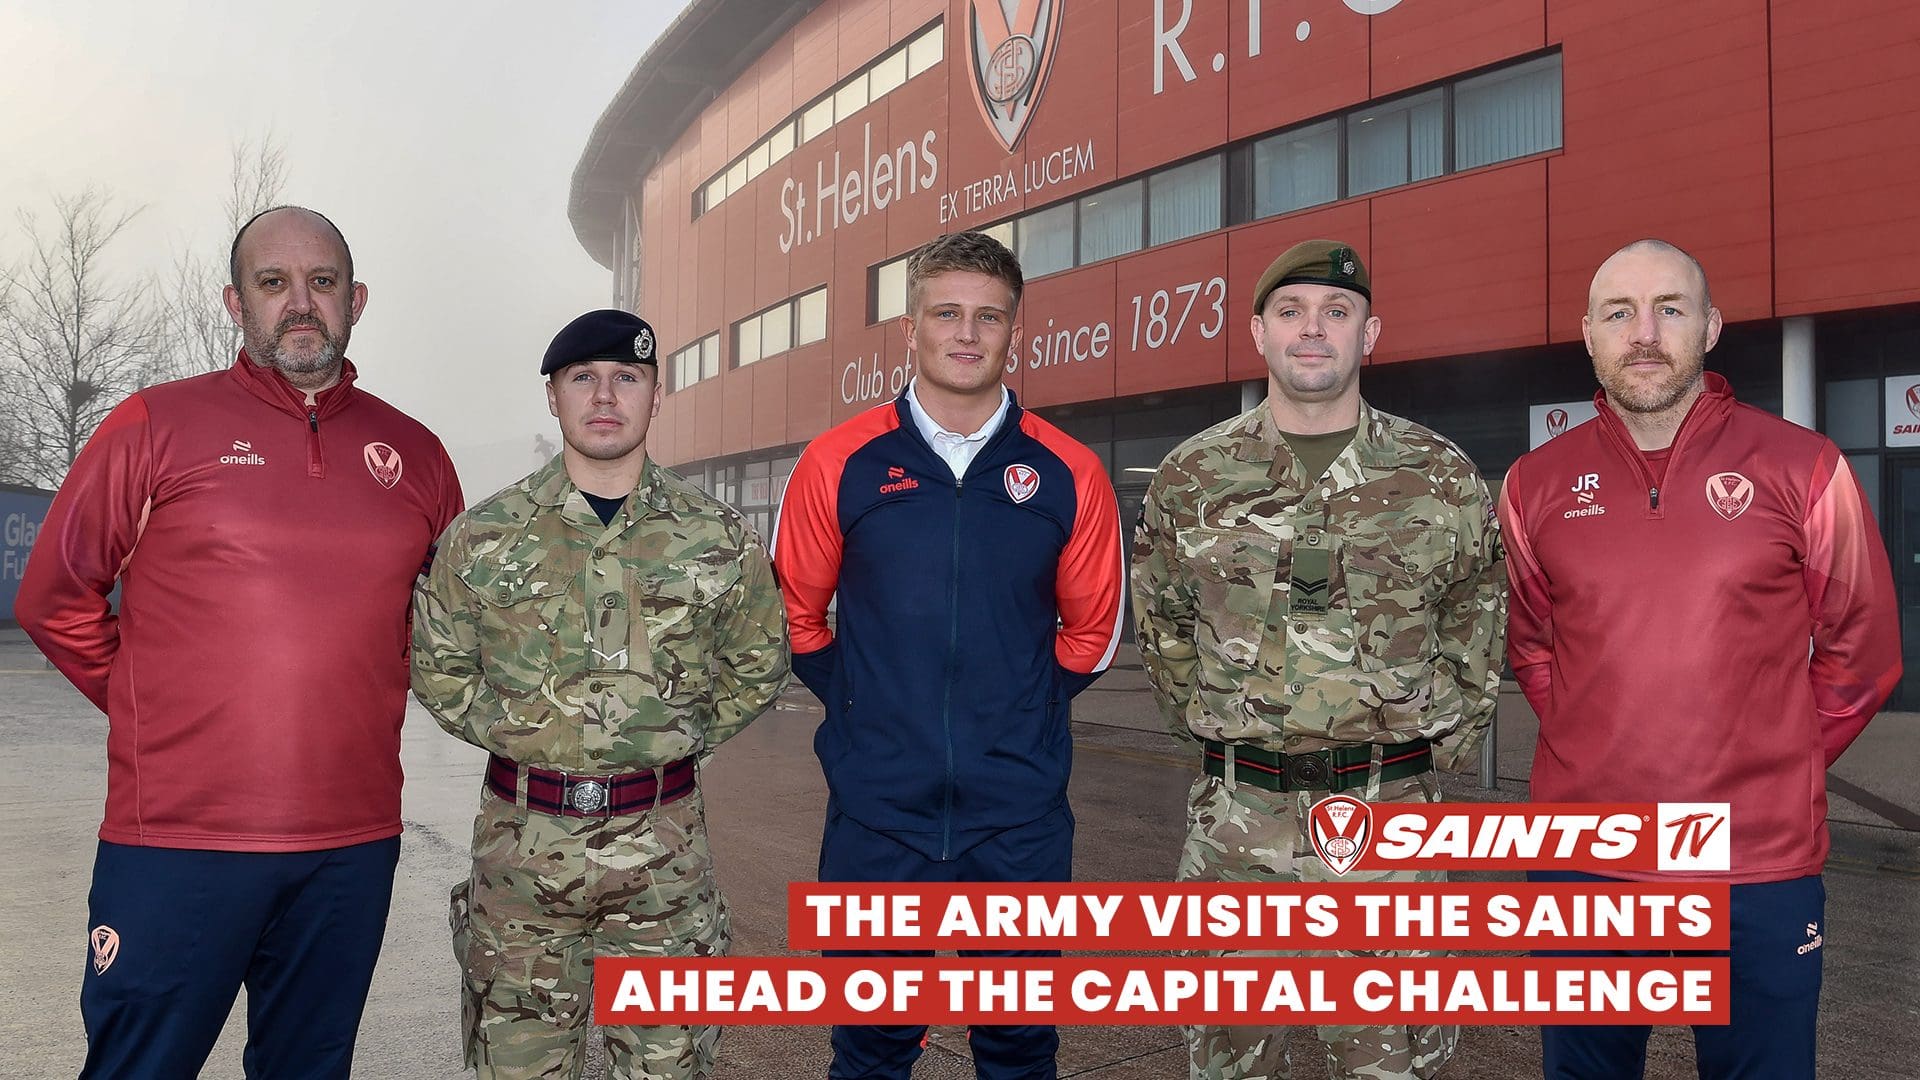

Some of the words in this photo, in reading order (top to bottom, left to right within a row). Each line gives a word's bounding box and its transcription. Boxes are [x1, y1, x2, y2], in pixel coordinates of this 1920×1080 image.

[940, 190, 958, 224] EX
[964, 169, 1018, 215] TERRA
[1024, 138, 1095, 194] LUCEM
[1029, 318, 1111, 370] since
[1131, 276, 1226, 352] 1873
[841, 352, 884, 405] Club
[890, 347, 912, 395] of
[1571, 473, 1600, 492] JR
